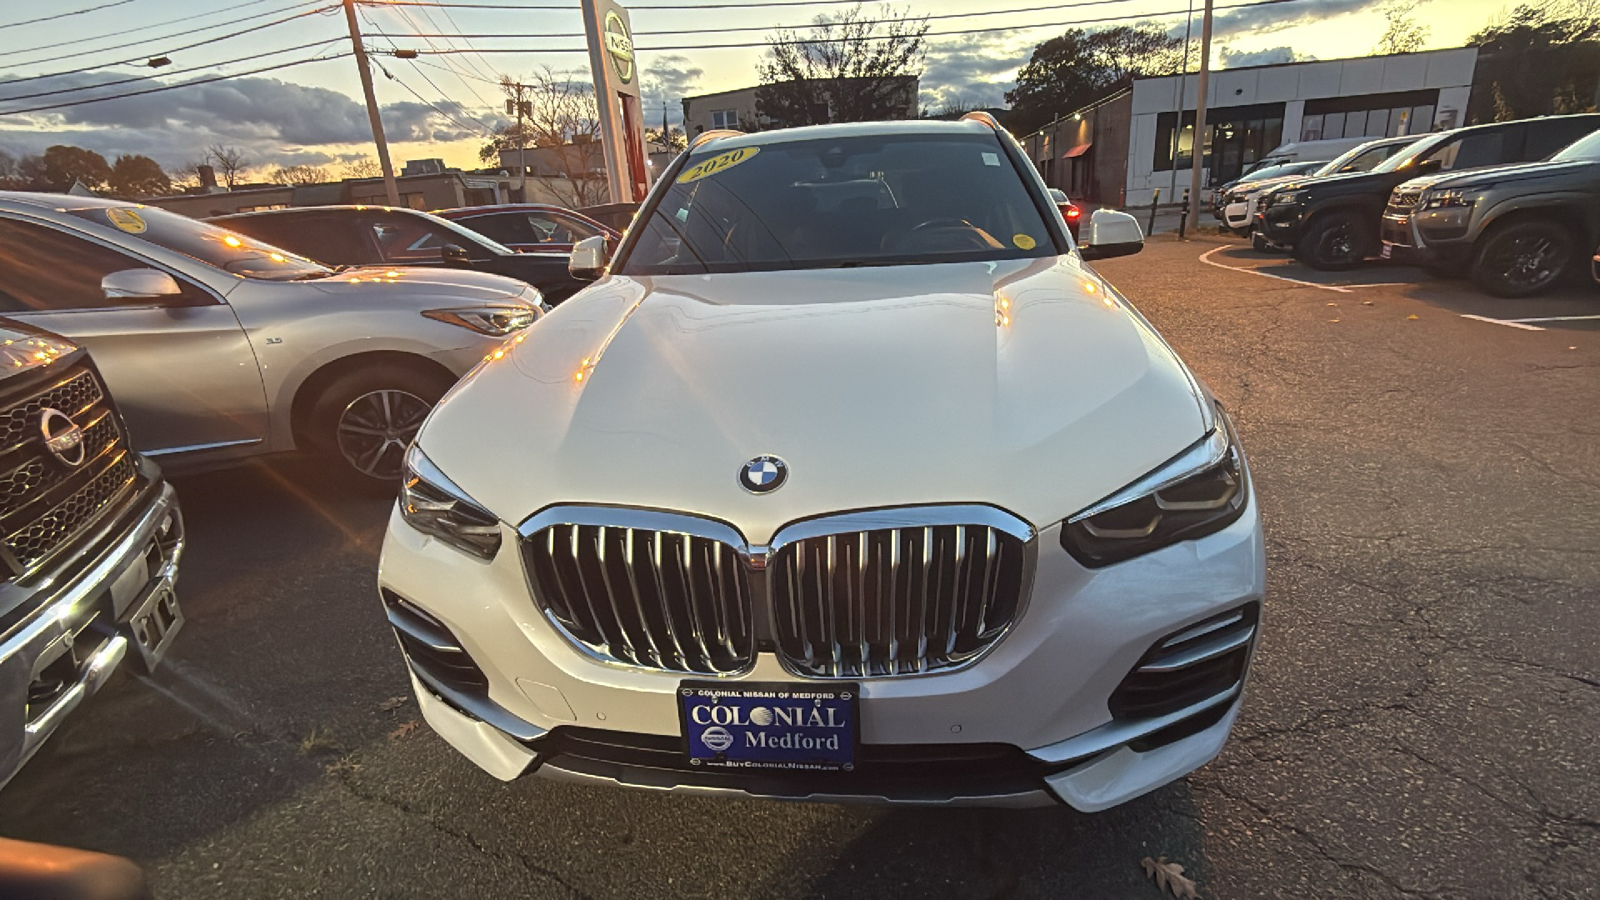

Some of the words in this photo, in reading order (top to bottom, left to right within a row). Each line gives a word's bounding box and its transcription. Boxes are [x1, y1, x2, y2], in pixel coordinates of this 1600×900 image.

[690, 149, 745, 181] 2020
[746, 456, 784, 468] BMW
[698, 690, 742, 698] COLONIAL
[743, 691, 776, 699] NISSAN
[745, 731, 840, 750] Medford
